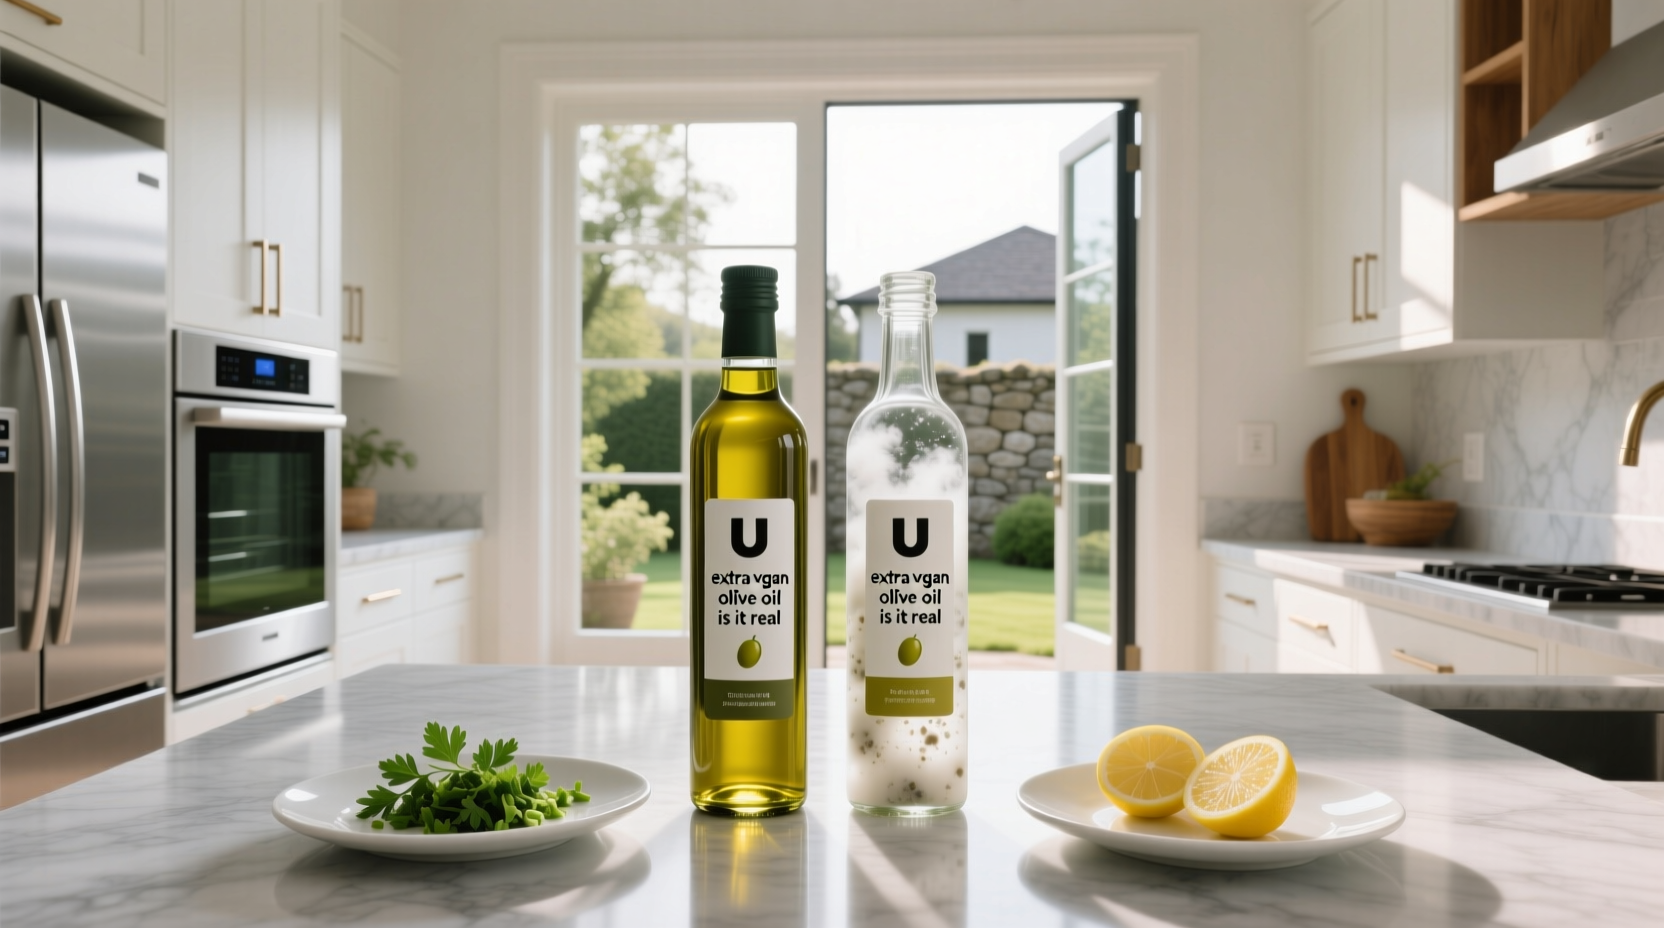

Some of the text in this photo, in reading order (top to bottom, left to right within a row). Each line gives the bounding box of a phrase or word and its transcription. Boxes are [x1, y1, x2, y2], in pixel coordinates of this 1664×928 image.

[730, 517, 768, 558] U
[892, 517, 929, 558] U
[711, 570, 789, 589] extra vgan
[871, 570, 950, 589] extra vgan
[718, 589, 781, 605] olive oil
[879, 588, 942, 604] olive oil
[718, 609, 781, 625] is it real
[880, 608, 942, 624] is it real
